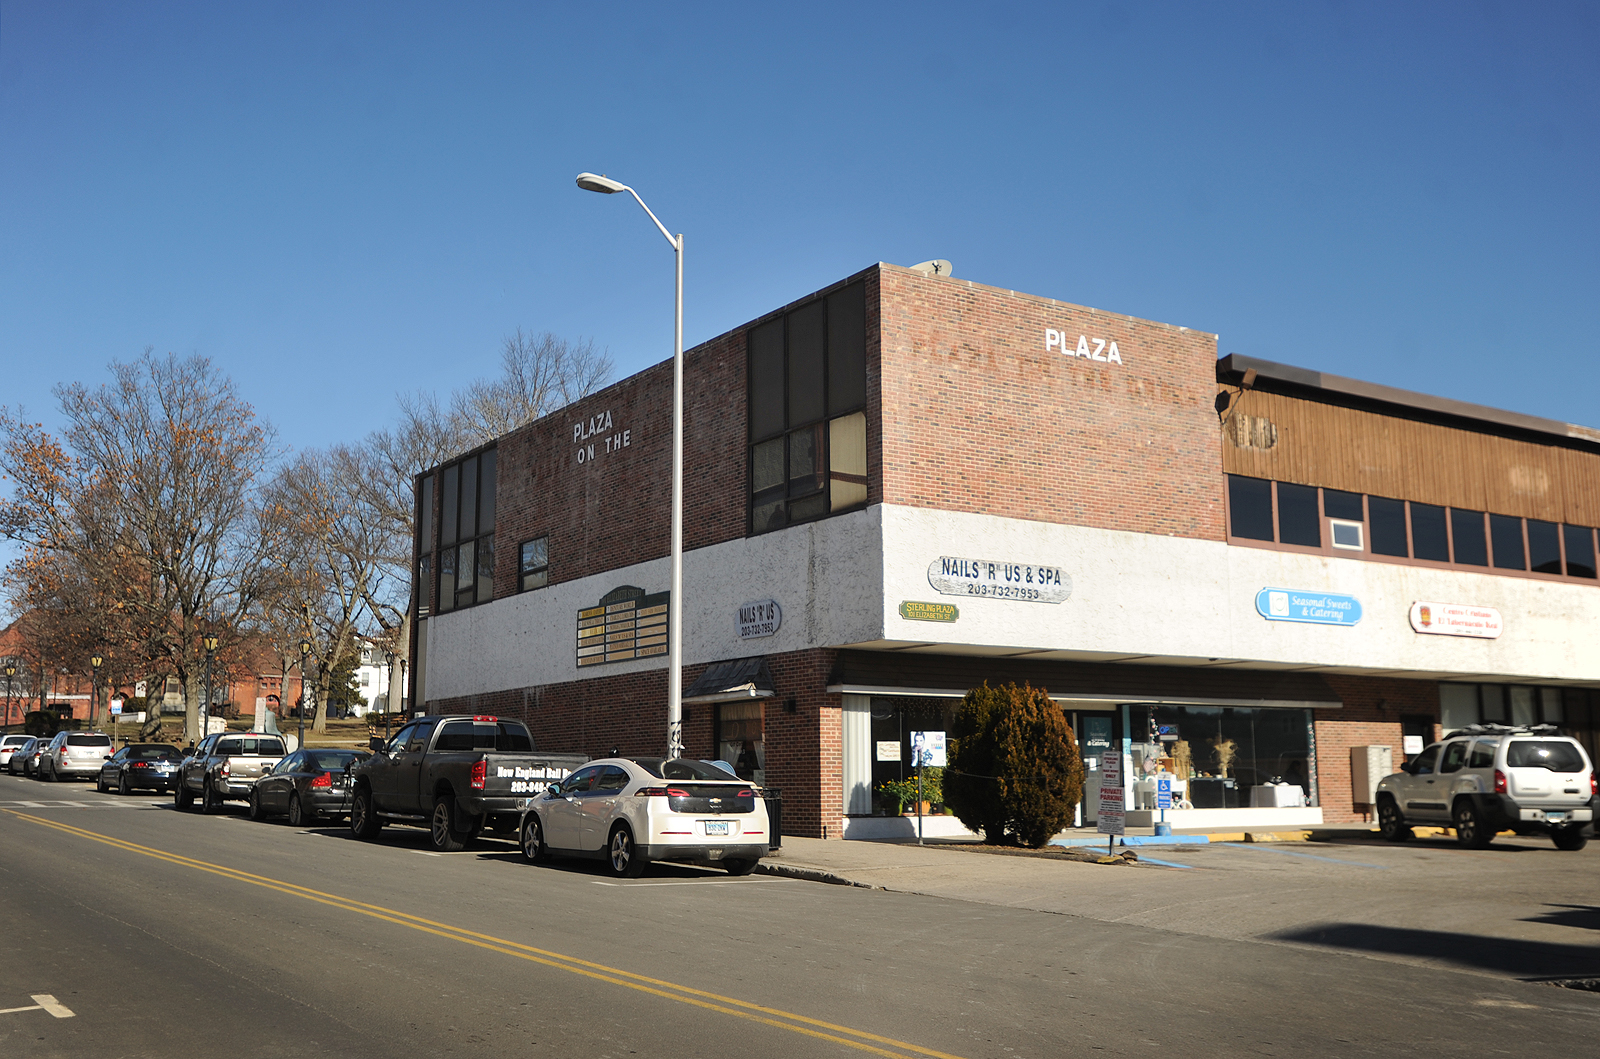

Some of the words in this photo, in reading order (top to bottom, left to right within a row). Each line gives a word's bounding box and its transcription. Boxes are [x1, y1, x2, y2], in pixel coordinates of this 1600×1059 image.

[1045, 328, 1122, 365] PLAZA
[573, 410, 613, 443] PLAZA
[577, 444, 595, 464] ON
[605, 429, 631, 453] THE
[942, 558, 979, 579] NAILS
[1005, 564, 1021, 582] US
[1026, 567, 1034, 584] &
[1038, 568, 1061, 586] SPA
[906, 602, 936, 612] STERLING
[936, 604, 955, 615] PLAZA
[1291, 595, 1326, 608] Seasonal
[1326, 597, 1352, 610] Sweets
[739, 606, 756, 625] NAILS
[766, 602, 775, 621] US
[916, 611, 944, 619] ELIZABETH
[1302, 608, 1309, 616] &
[1309, 607, 1344, 622] Catering
[741, 622, 773, 637] 203-732-7953
[497, 766, 514, 778] New
[515, 766, 546, 781] England
[1099, 794, 1123, 802] PARKING
[1100, 787, 1123, 795] PRIVATE
